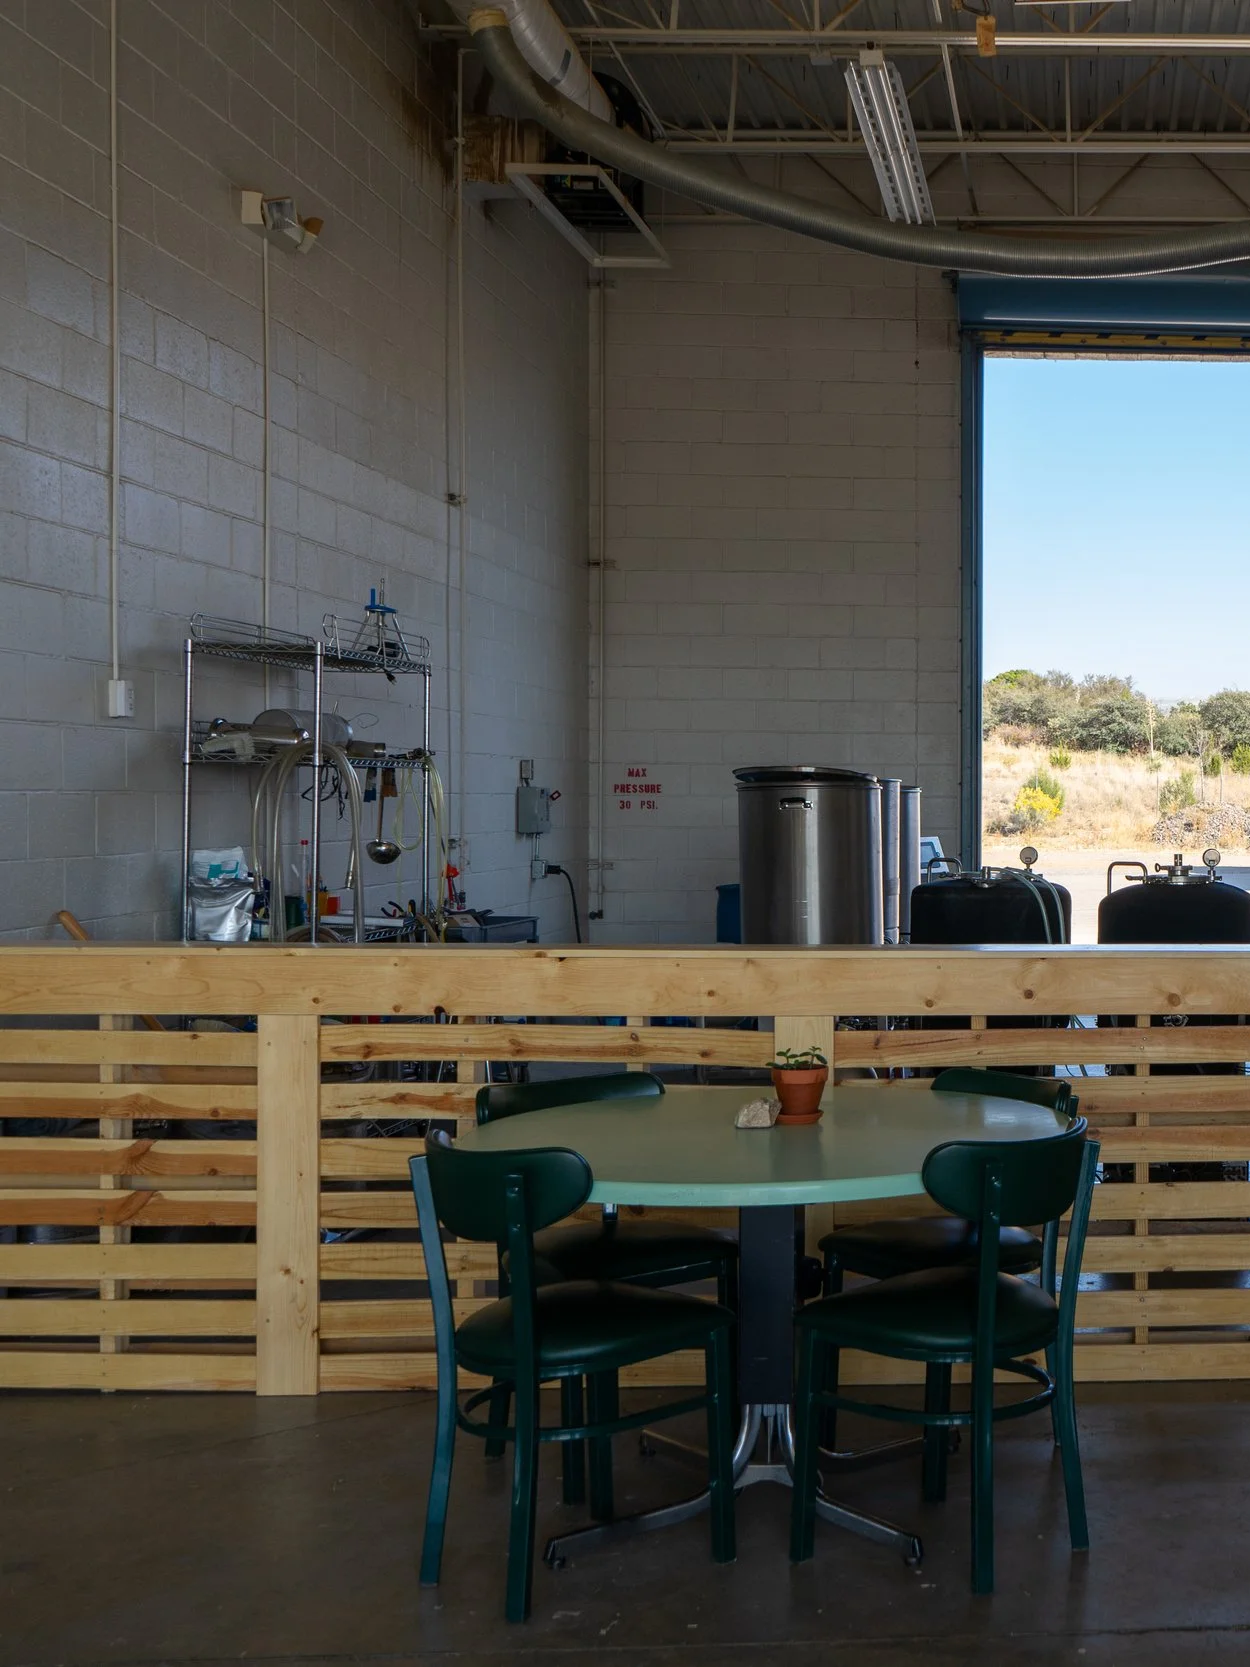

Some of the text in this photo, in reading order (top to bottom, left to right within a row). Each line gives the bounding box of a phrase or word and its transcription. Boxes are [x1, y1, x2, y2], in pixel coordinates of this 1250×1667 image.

[627, 768, 647, 778] MAX
[614, 784, 662, 794] PRESSURE
[619, 800, 631, 810] 30
